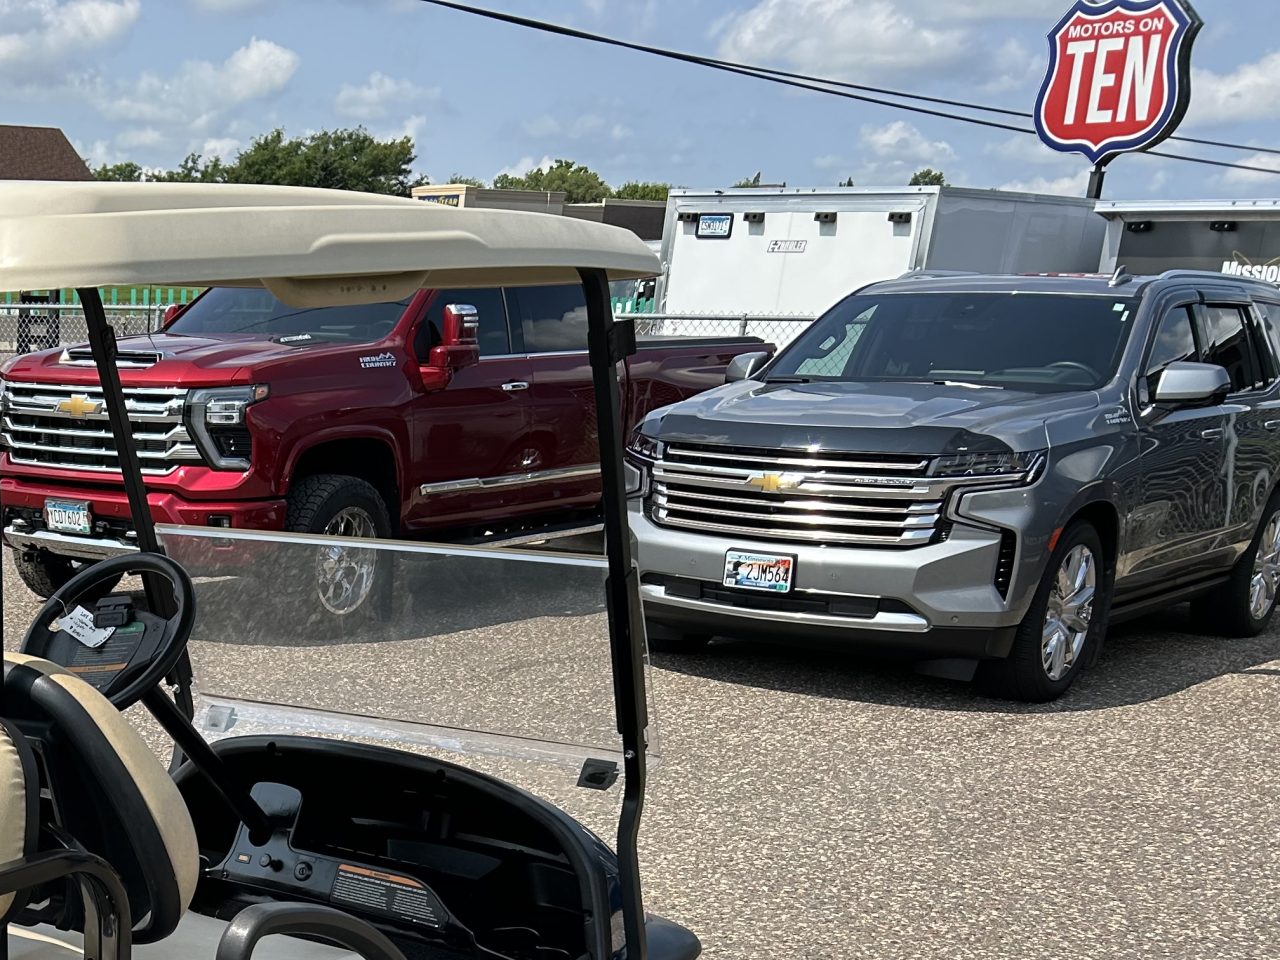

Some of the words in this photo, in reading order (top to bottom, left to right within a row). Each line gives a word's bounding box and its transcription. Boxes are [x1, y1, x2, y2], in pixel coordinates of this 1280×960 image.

[1068, 18, 1135, 39] MOTORS
[1139, 17, 1165, 31] ON
[1063, 33, 1162, 125] TEN
[49, 509, 82, 527] YCD7602
[746, 562, 789, 584] 2JM564
